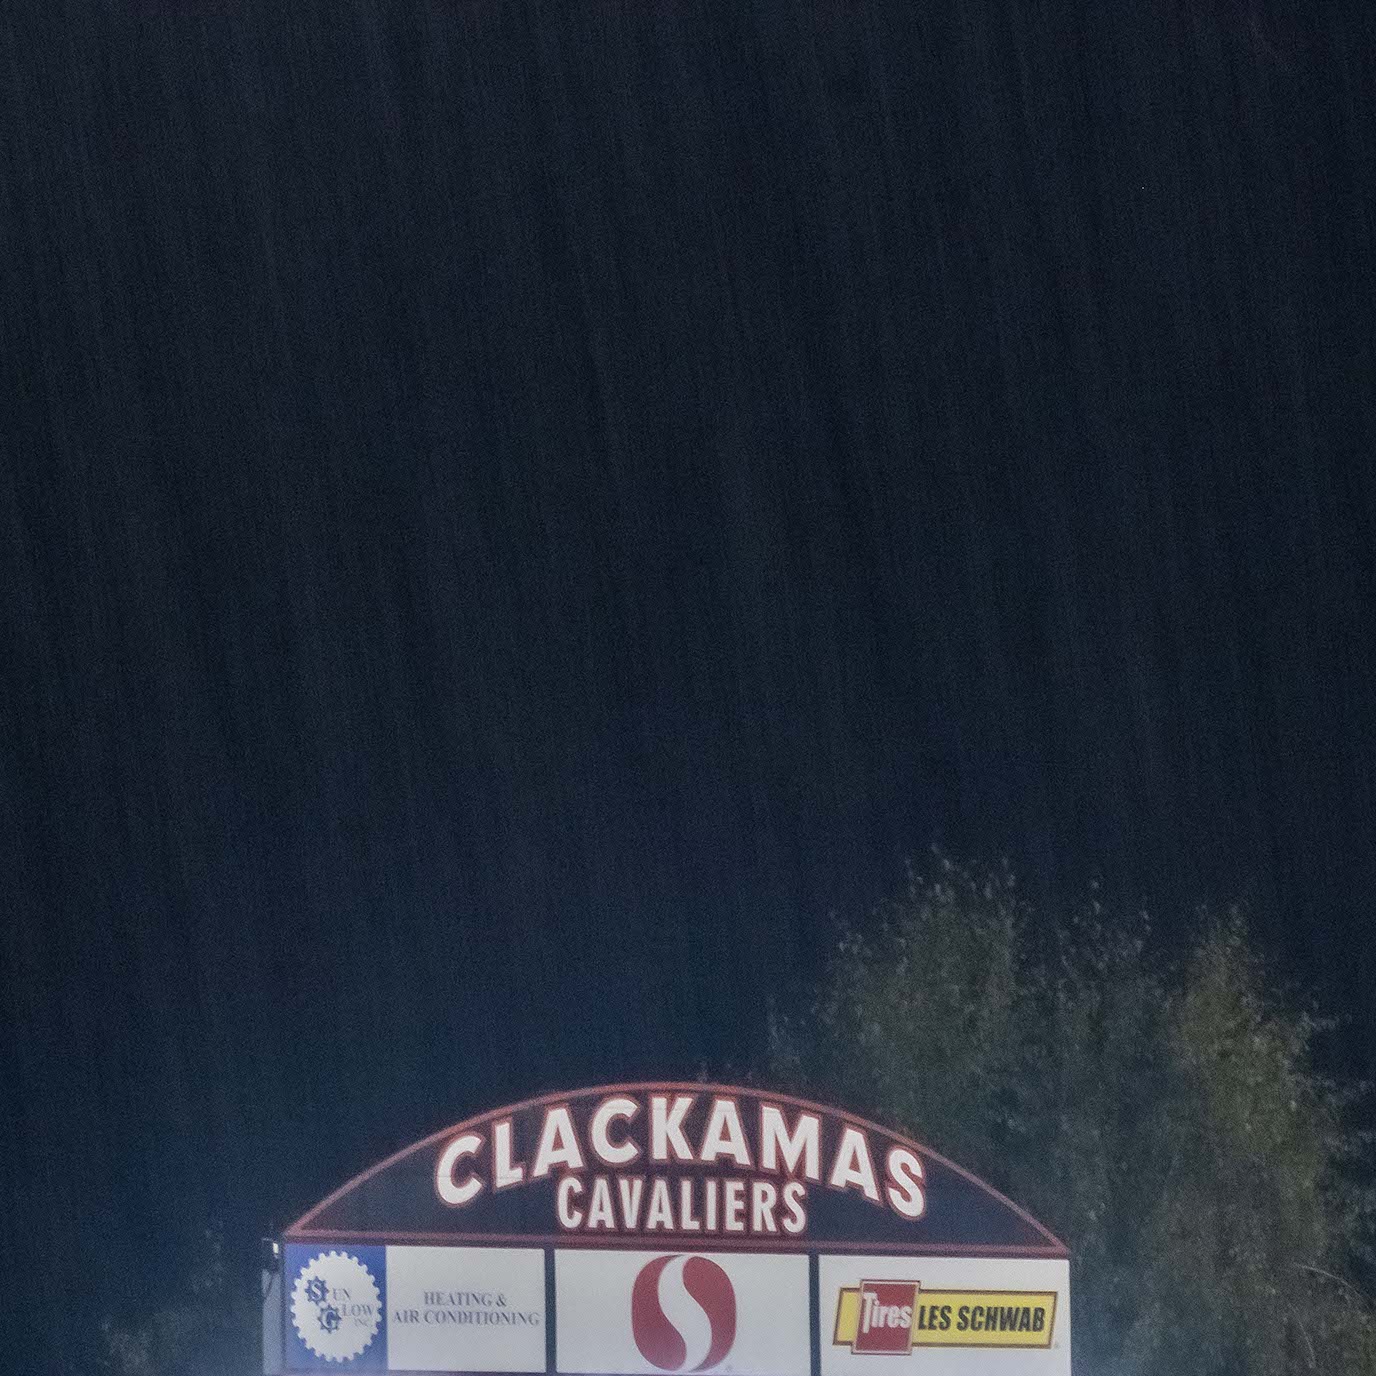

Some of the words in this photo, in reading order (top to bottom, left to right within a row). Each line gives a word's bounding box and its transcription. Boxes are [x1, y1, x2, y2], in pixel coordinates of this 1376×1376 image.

[435, 1095, 926, 1220] CLACKAMAS
[557, 1176, 808, 1235] CAVALIERS
[424, 1291, 490, 1307] HEATING
[495, 1294, 508, 1307] &
[862, 1291, 914, 1334] Tires
[392, 1310, 420, 1324] AIR
[424, 1311, 540, 1326] CONDITIONING
[917, 1304, 952, 1331] LES
[955, 1305, 1046, 1333] SCHWAB
